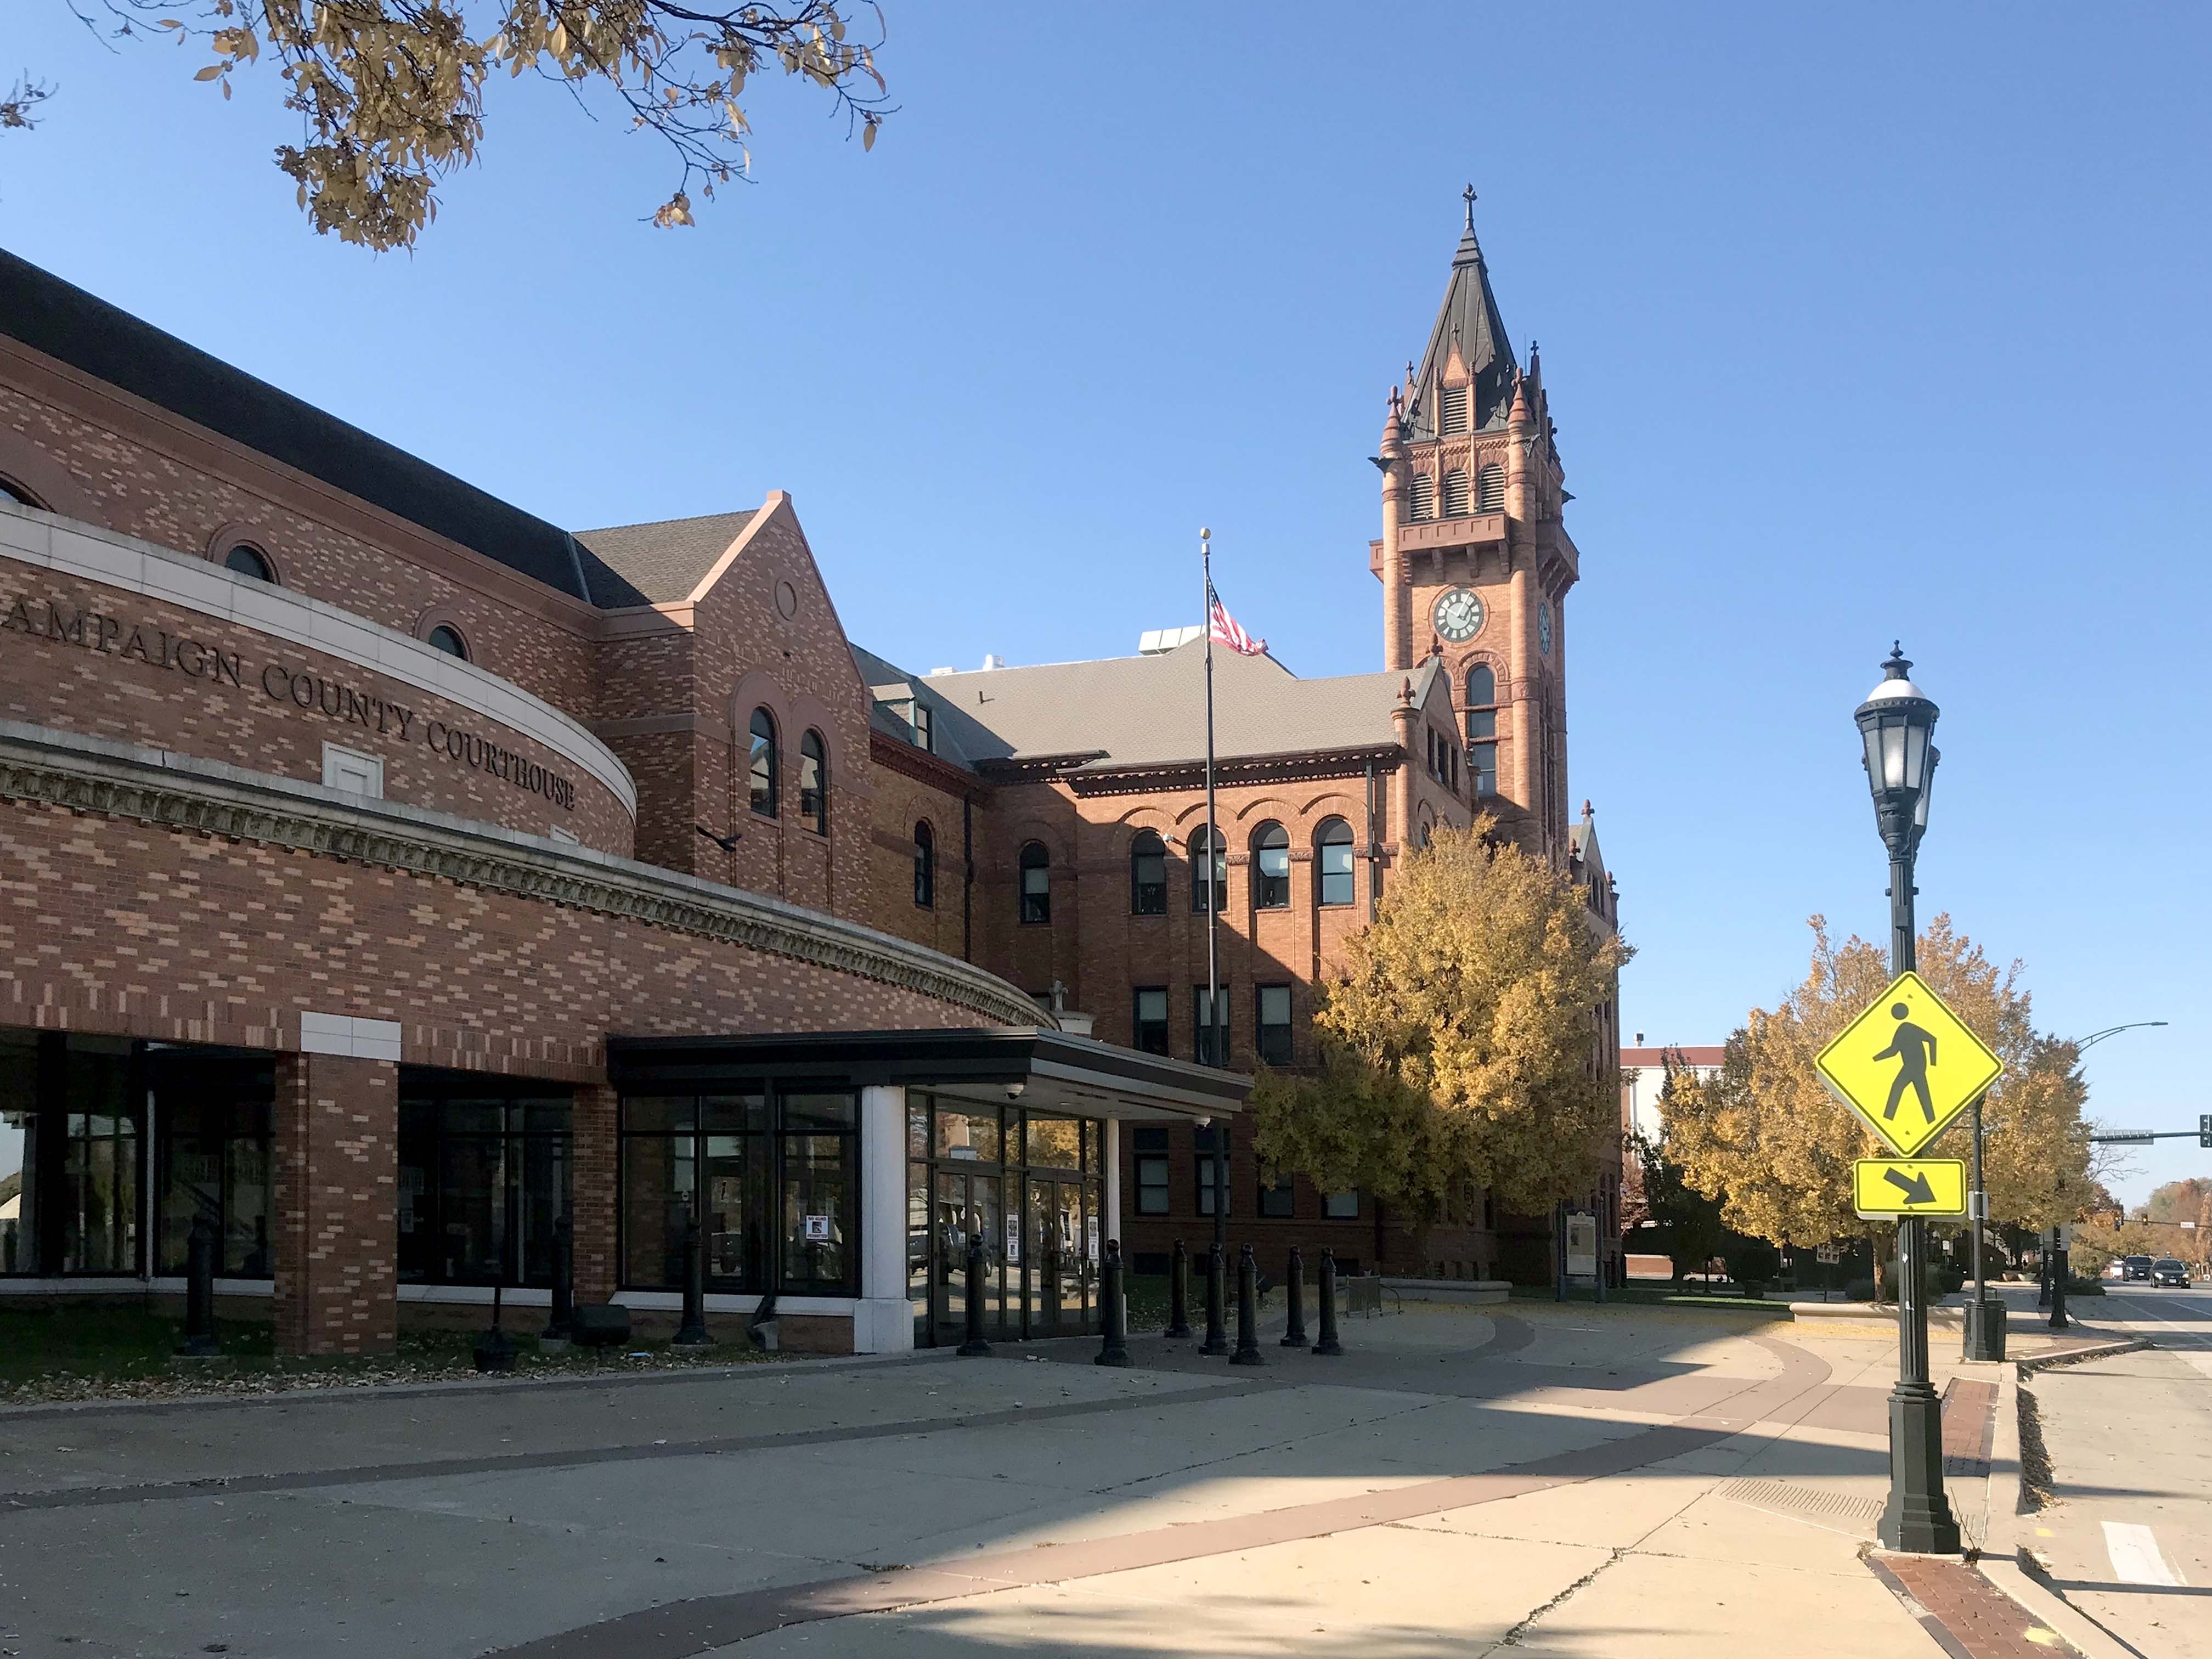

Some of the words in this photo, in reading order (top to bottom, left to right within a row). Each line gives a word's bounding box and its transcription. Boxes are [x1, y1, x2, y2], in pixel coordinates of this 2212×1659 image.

[1, 594, 245, 689] AMPAIGN
[262, 664, 413, 741] COUNTY
[427, 720, 575, 811] COURTHOUSE
